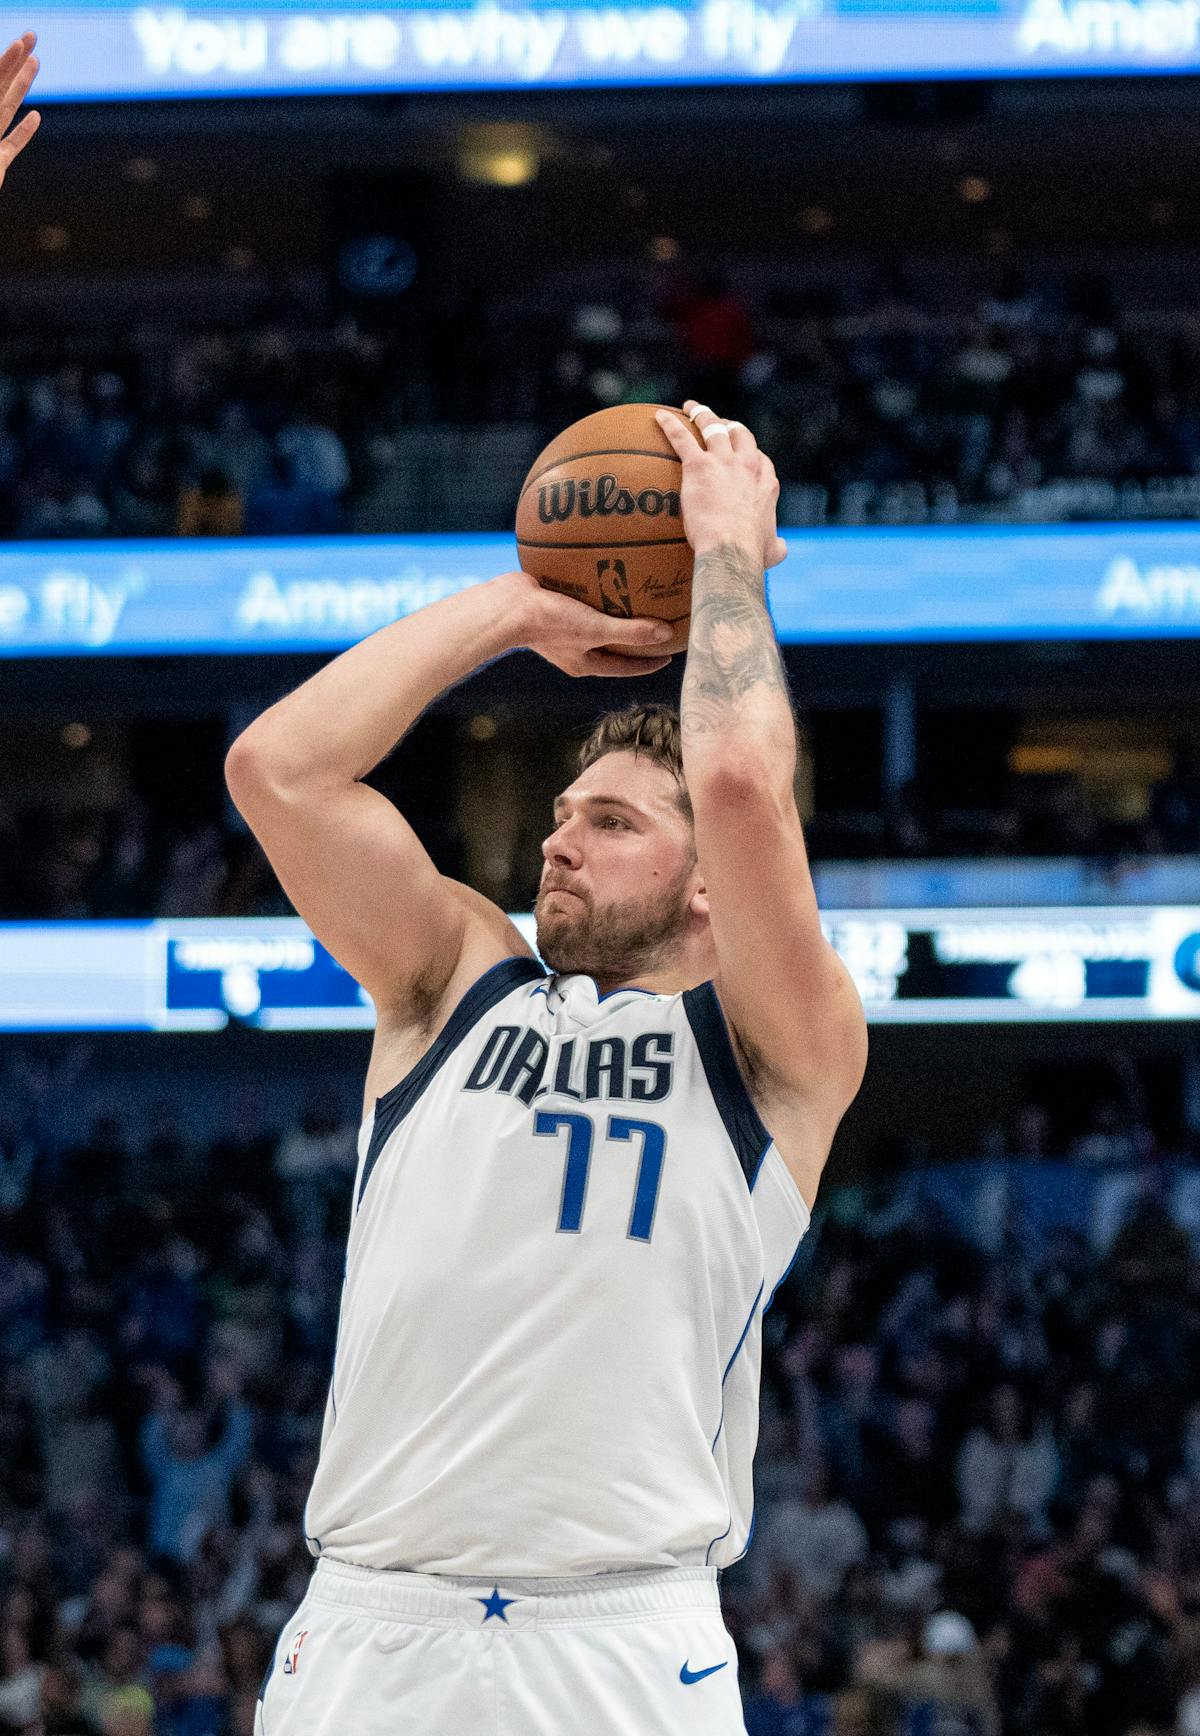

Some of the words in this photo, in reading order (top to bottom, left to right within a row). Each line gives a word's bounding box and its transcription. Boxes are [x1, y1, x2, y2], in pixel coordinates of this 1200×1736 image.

[132, 6, 267, 76] You
[281, 14, 398, 70] are
[412, 0, 568, 80] why
[578, 8, 688, 64] we
[702, 0, 798, 75] fly
[40, 570, 128, 648] fly
[532, 1108, 668, 1244] 77
